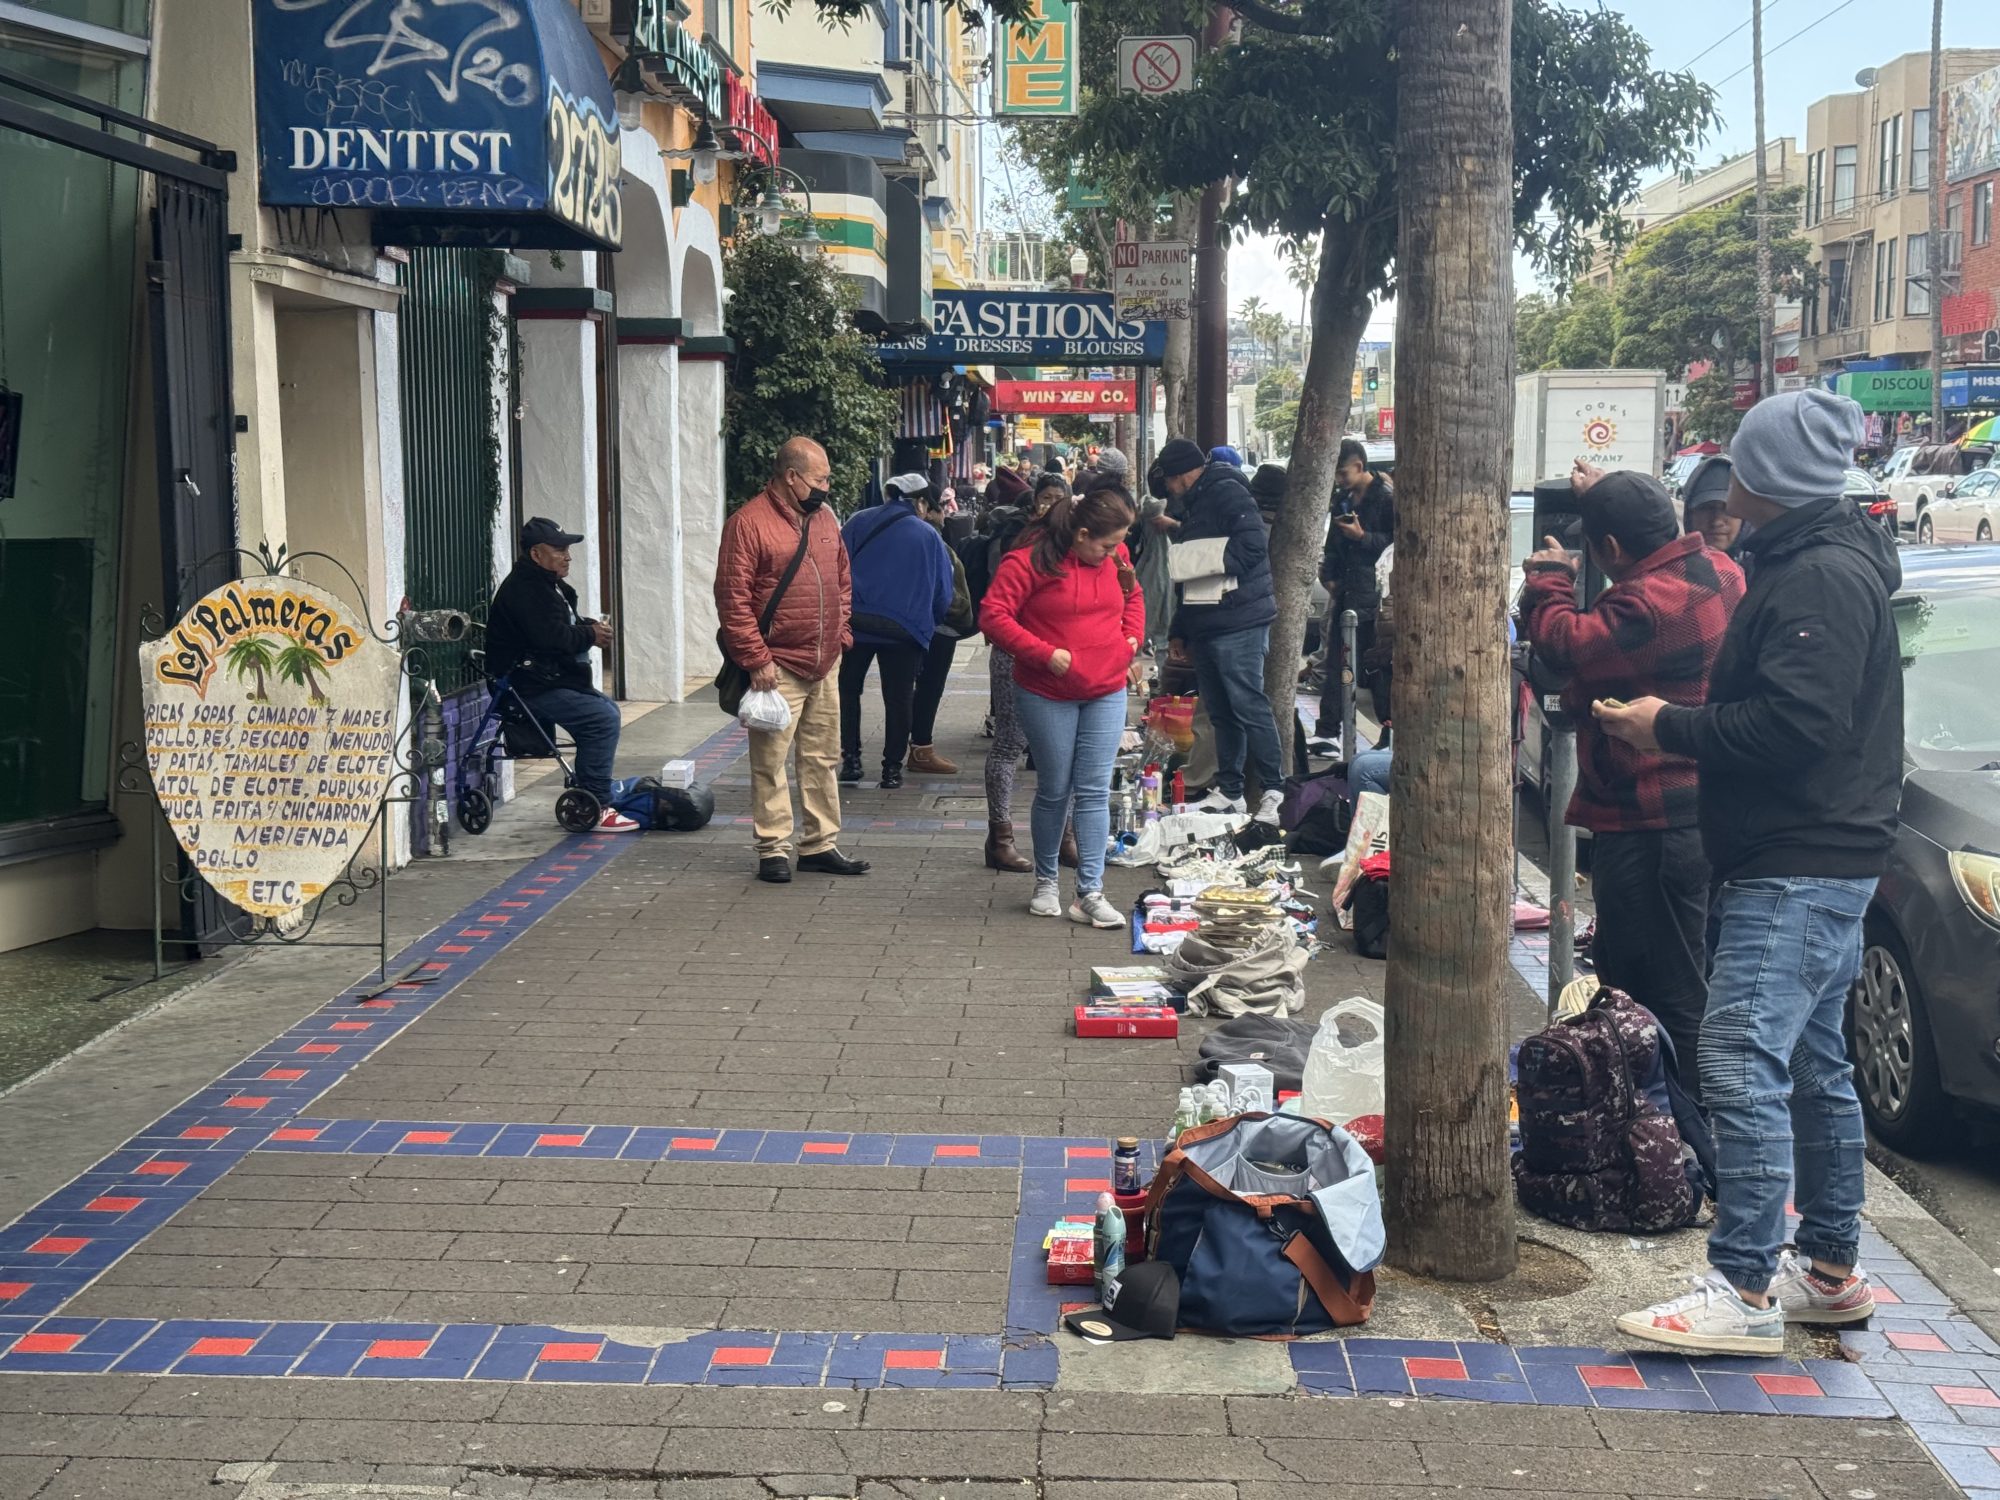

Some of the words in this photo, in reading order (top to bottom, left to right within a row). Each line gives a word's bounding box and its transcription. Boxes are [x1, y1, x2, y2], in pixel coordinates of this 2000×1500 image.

[288, 127, 512, 175] DENTIST
[551, 95, 622, 244] 2725
[1117, 245, 1137, 265] NO
[1142, 249, 1188, 265] PARKING
[1124, 272, 1133, 287] 4
[1160, 272, 1168, 286] 6
[1136, 289, 1169, 298] EVERYDAY
[955, 338, 1033, 354] DRESSES
[1064, 341, 1144, 356] BLOUSES
[1872, 377, 1932, 391] DISCOU
[1022, 391, 1055, 403] WIN
[1100, 390, 1128, 403] CO.
[1575, 402, 1626, 416] COOKS
[191, 589, 354, 661] Palmeras
[145, 702, 184, 723] RICAS
[247, 705, 317, 726] CAMARON
[325, 707, 337, 726] 7
[340, 709, 391, 727] MARES
[239, 730, 310, 751] PESCADO
[224, 753, 298, 774] TAMALES
[306, 755, 329, 774] DE
[336, 755, 390, 775] ELOTE
[157, 775, 200, 796] ATOL
[210, 776, 236, 797] DE
[212, 800, 262, 821] FRITA
[234, 825, 349, 848] MERIENDA
[196, 849, 259, 868] POLLO
